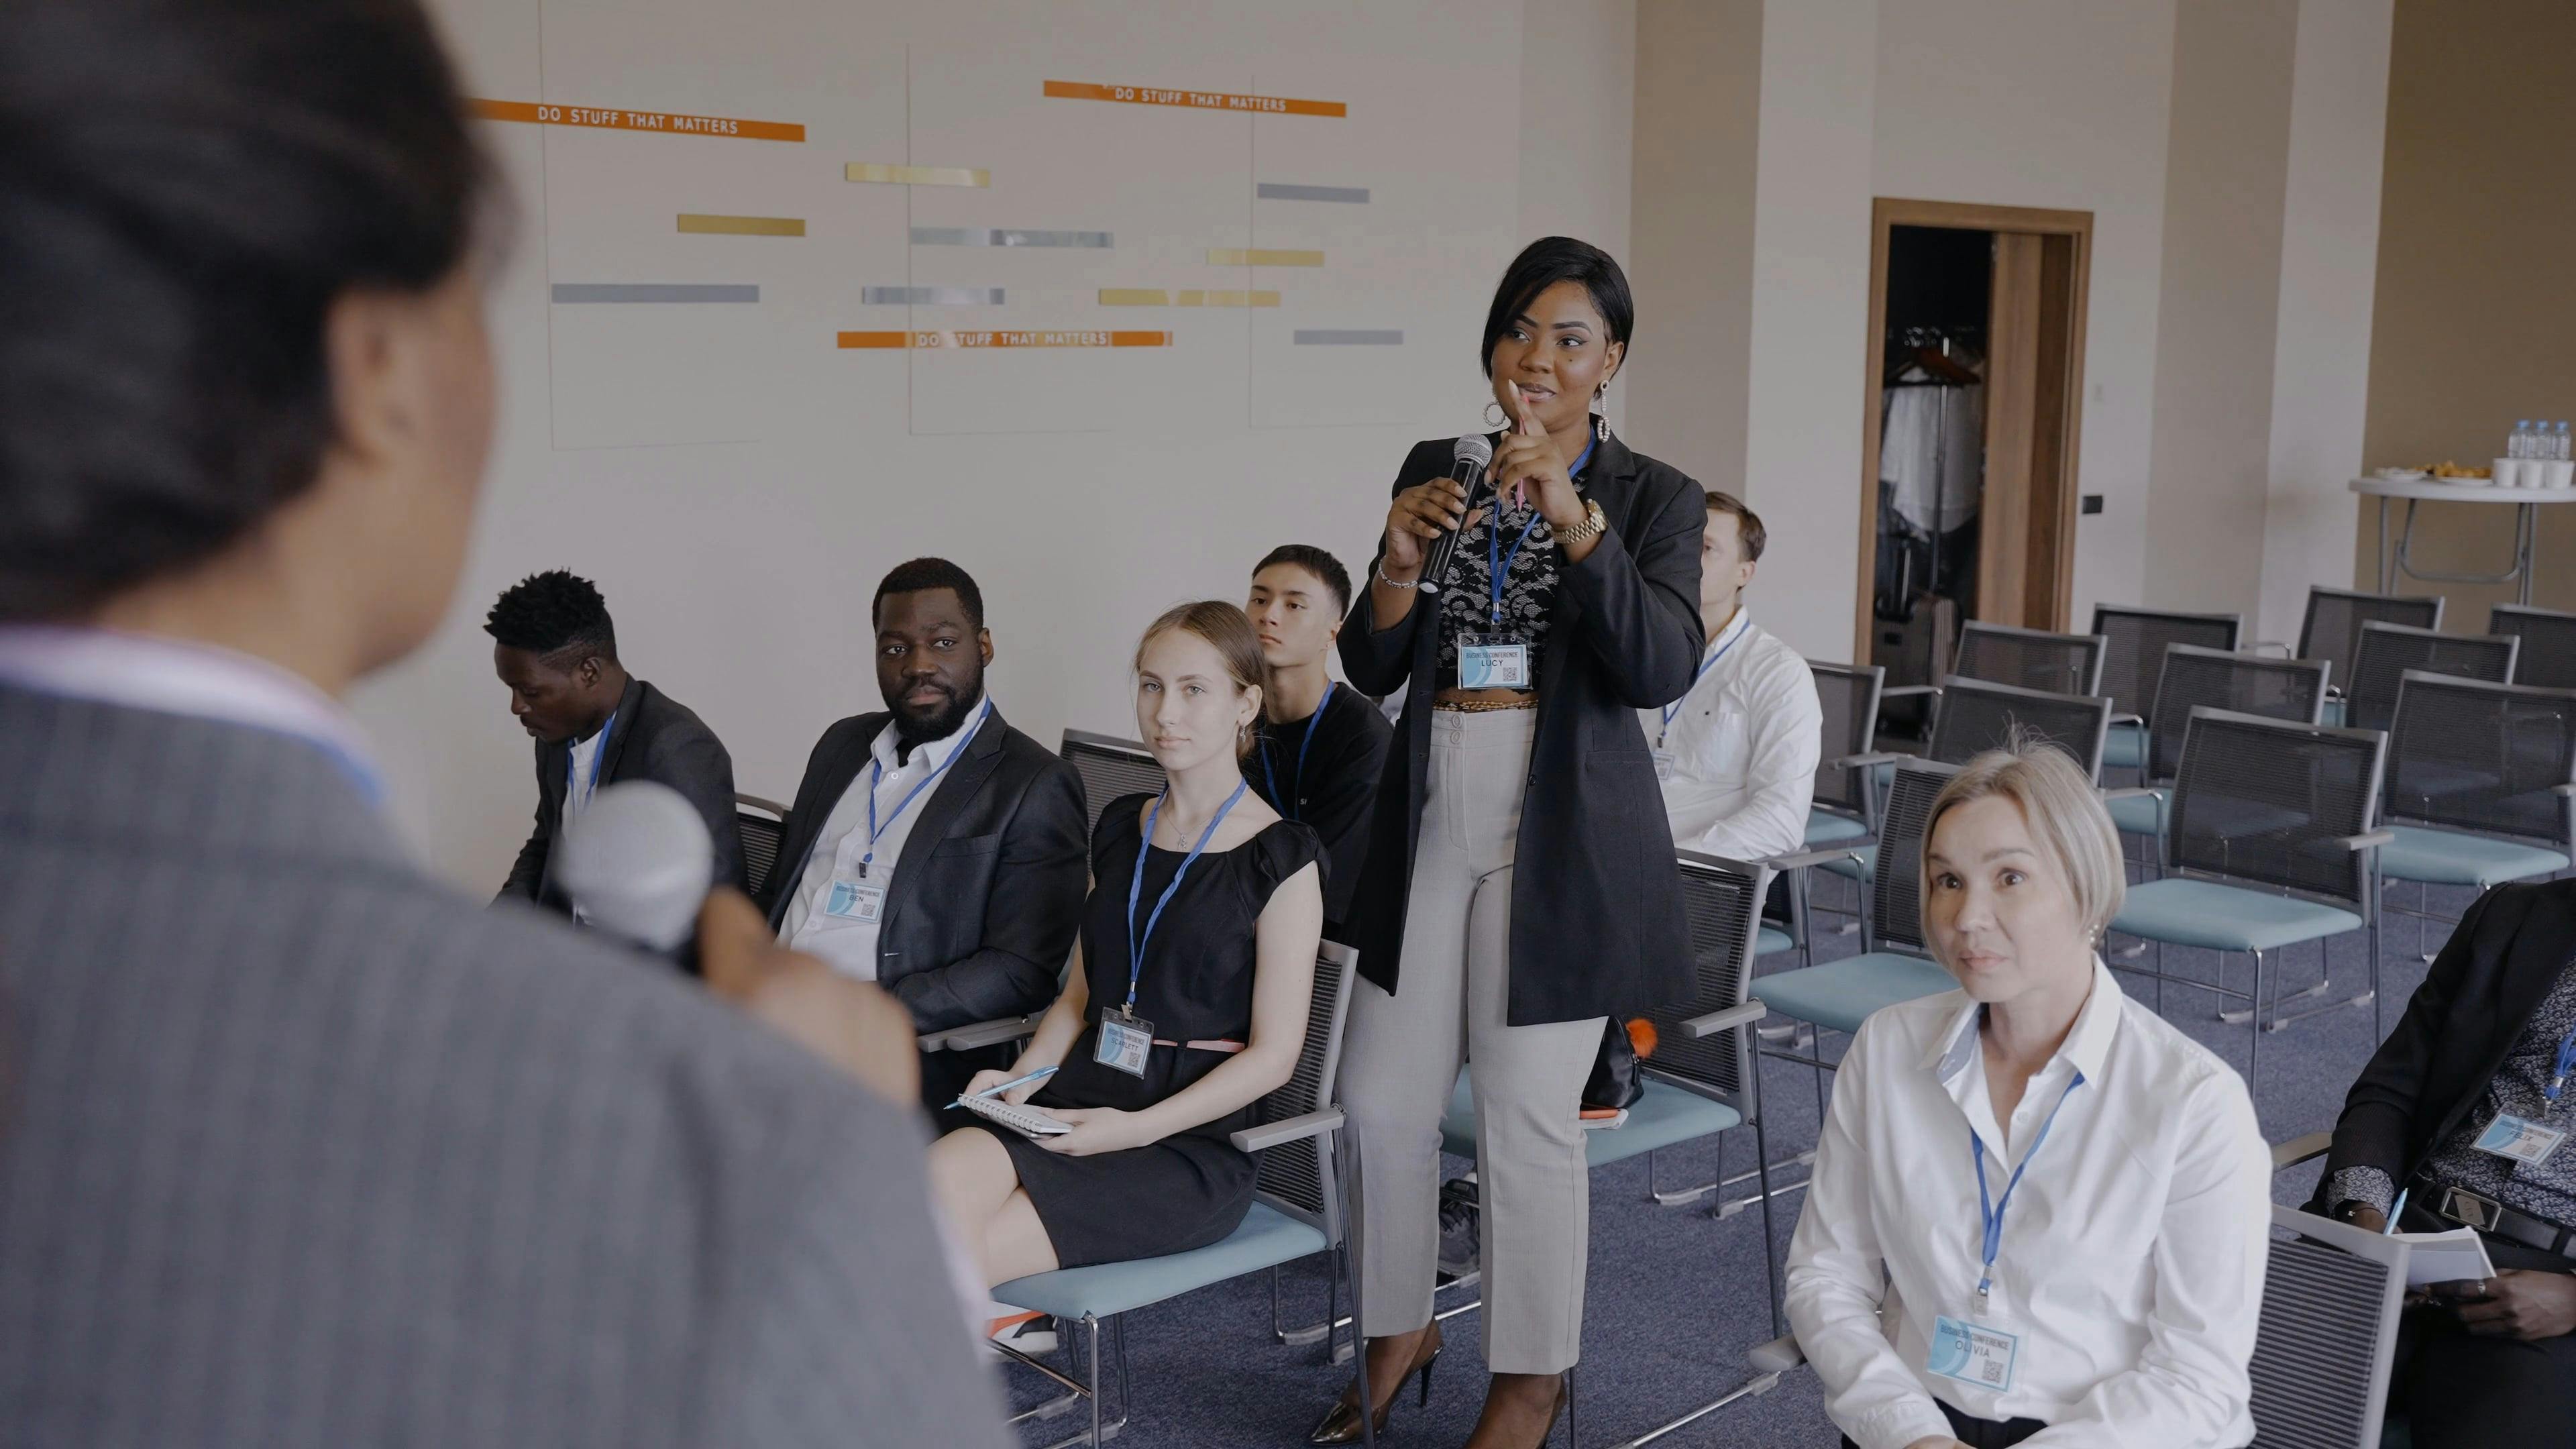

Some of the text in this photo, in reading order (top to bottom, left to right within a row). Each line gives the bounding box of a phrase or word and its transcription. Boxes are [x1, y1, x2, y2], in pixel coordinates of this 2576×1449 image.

[1115, 87, 1287, 112] DO STUFF THAT MATTERS
[538, 107, 738, 135] DO STUFF THAT MATTERS
[918, 333, 939, 347] DO
[1000, 333, 1036, 345] THAT
[1044, 332, 1107, 345] MATTERS
[849, 894, 864, 902] BEN
[1111, 1036, 1138, 1051] SCARLETT
[1955, 1340, 1990, 1358] OLIVIA
[1970, 1333, 2010, 1350] CONFERENCE
